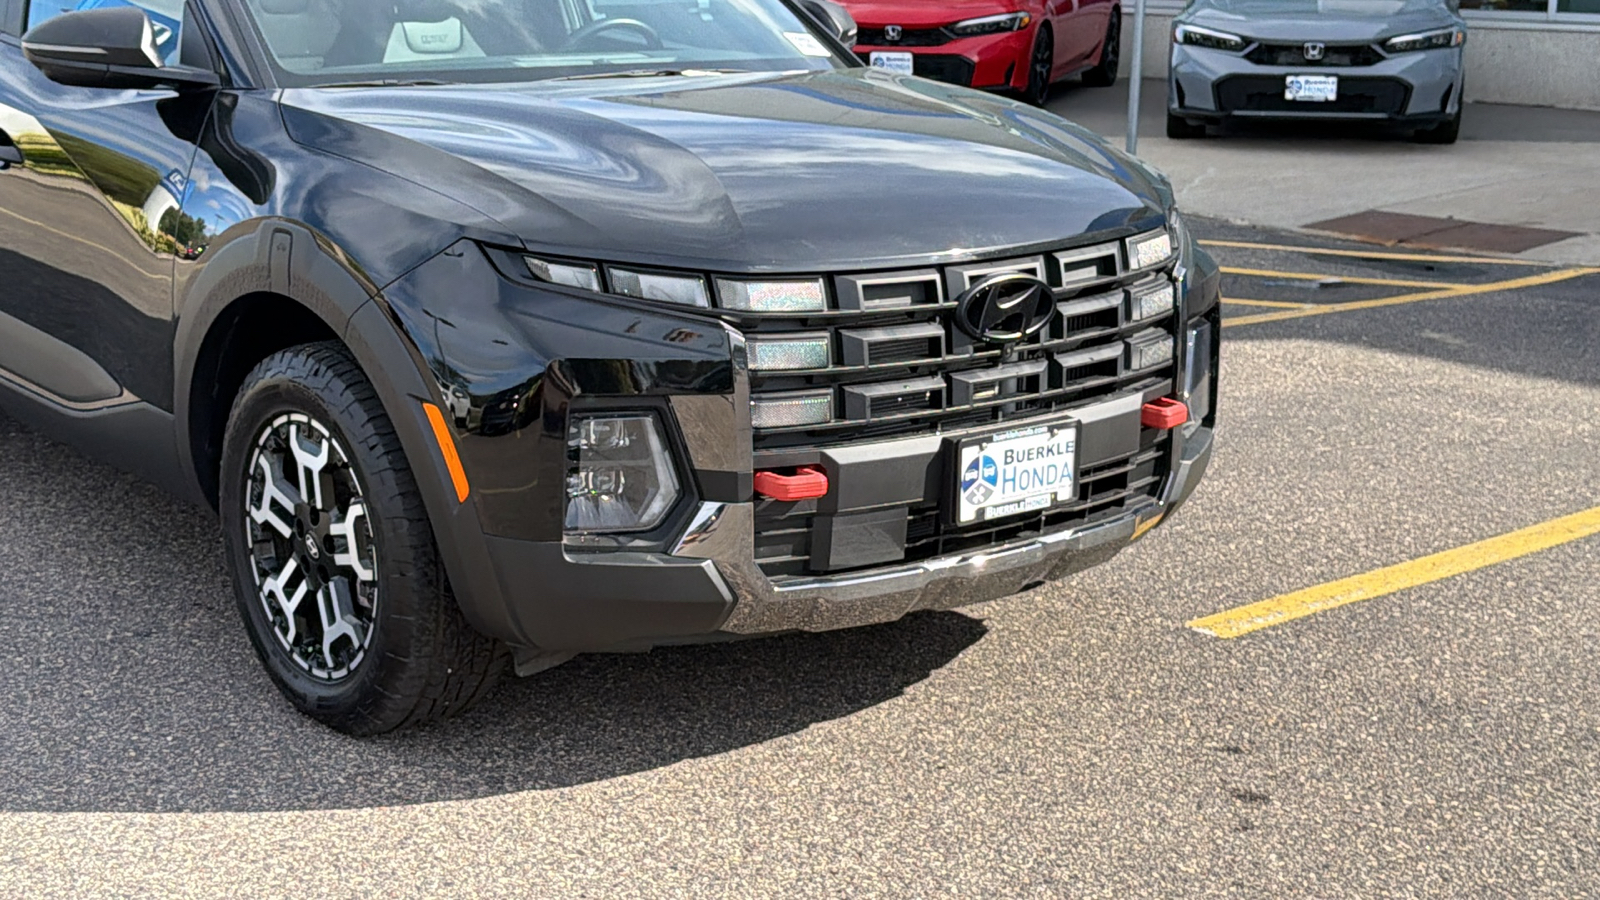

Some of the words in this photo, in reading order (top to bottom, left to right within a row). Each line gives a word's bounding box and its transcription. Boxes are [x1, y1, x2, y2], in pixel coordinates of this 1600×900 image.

[1004, 440, 1075, 465] BUERKLE
[1001, 462, 1073, 494] HONDA
[986, 501, 1026, 519] BUERKLE
[1027, 498, 1049, 509] HONDA
